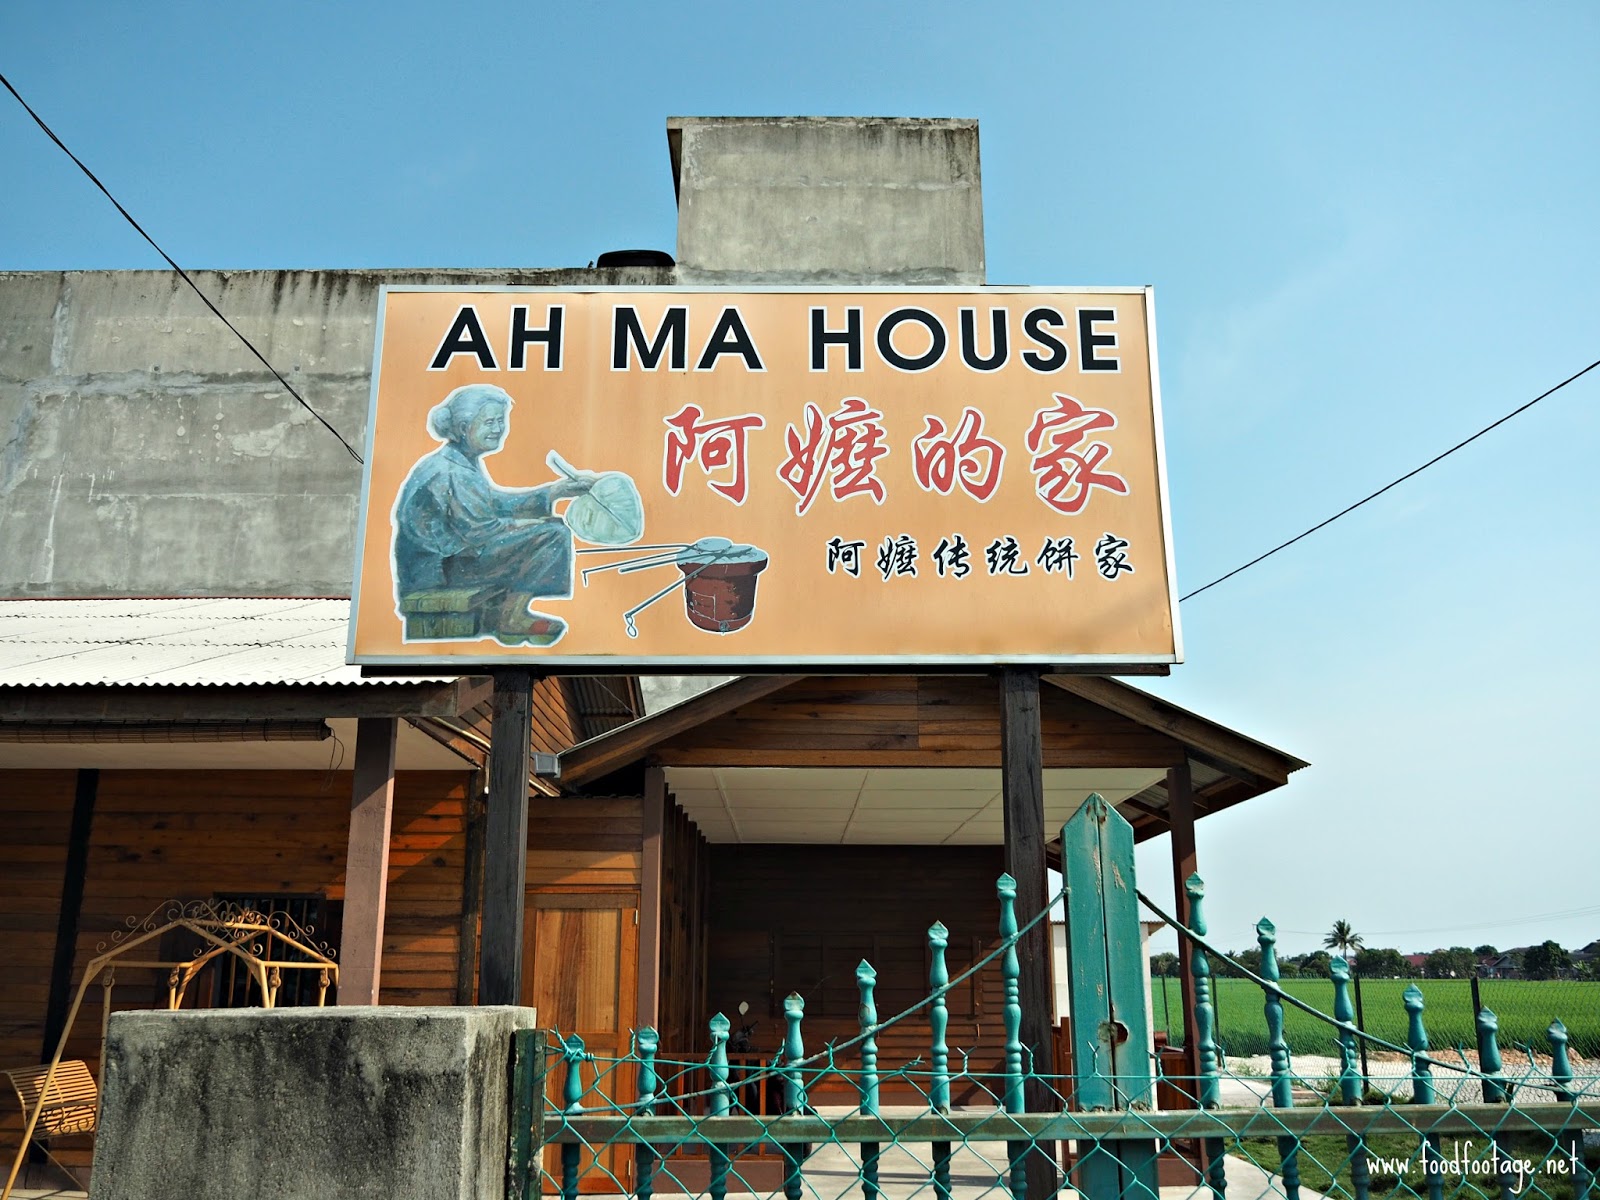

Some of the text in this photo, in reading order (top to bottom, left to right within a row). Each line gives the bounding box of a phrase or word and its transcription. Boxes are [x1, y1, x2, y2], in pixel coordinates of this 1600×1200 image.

[428, 305, 1120, 373] AH MA HOUSE
[664, 393, 1128, 515] 阿嬷的家
